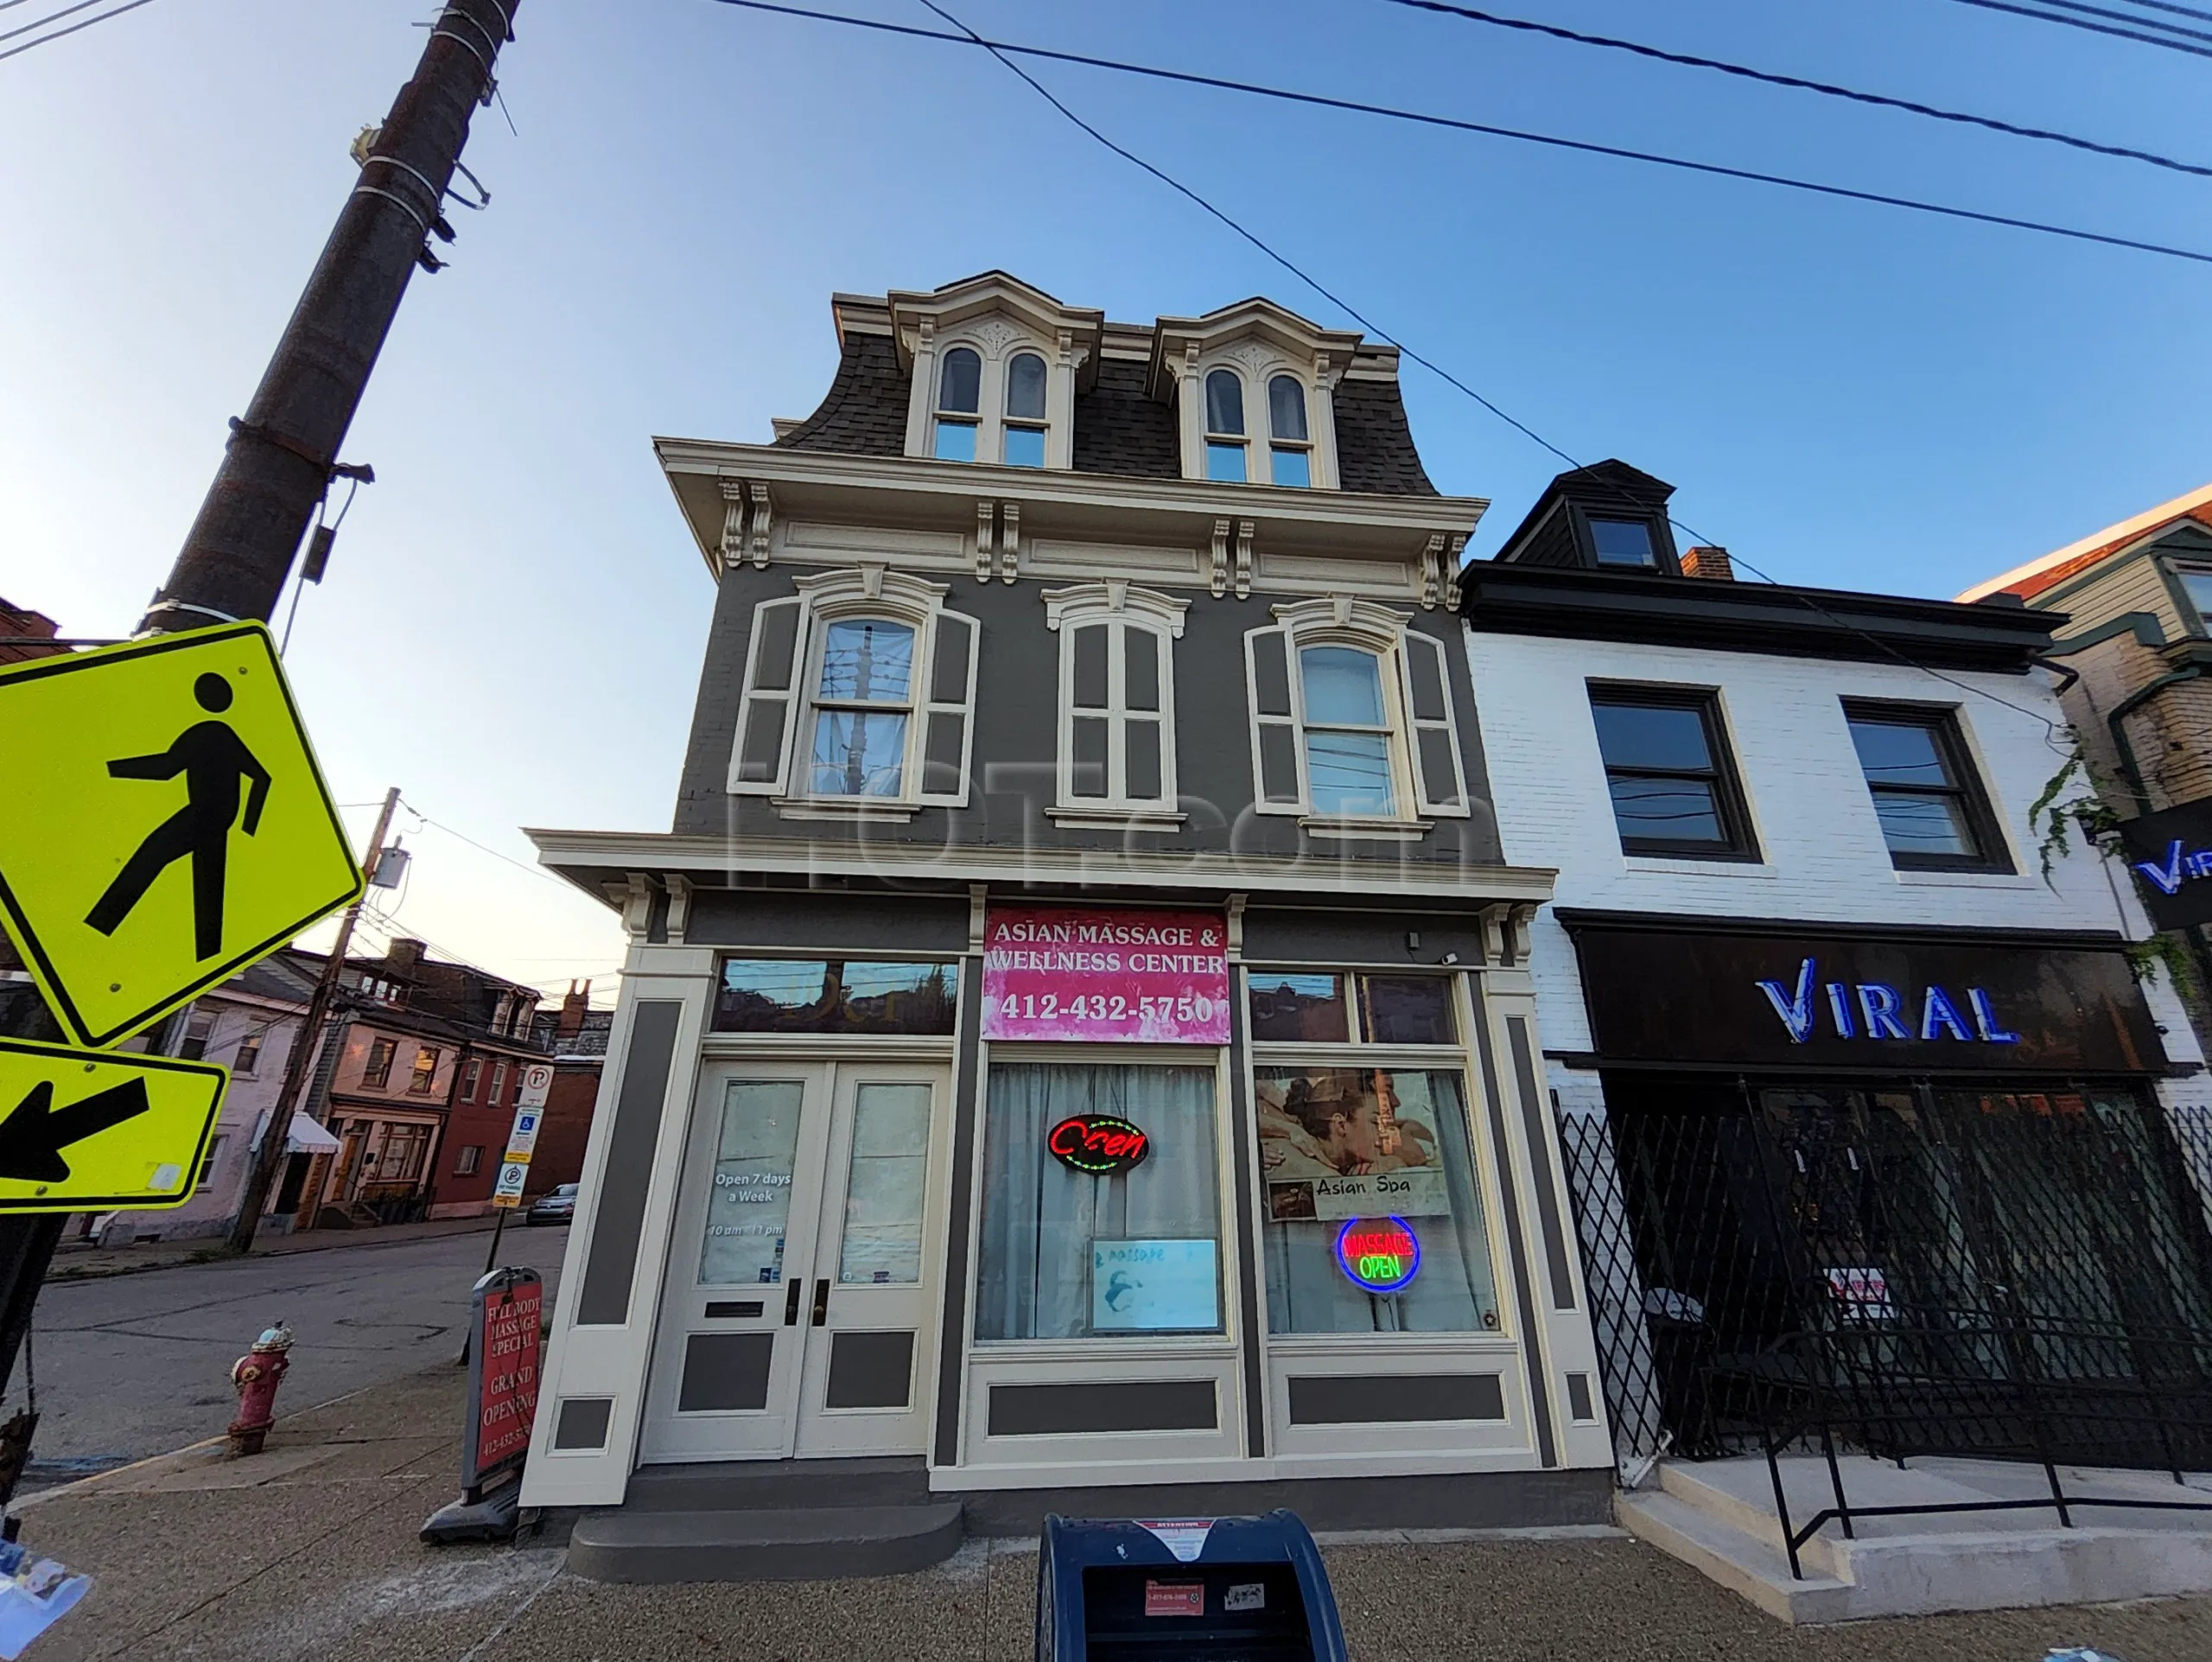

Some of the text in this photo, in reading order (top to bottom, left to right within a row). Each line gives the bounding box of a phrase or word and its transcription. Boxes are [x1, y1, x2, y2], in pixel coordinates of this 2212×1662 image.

[994, 922, 1220, 947] ASIAN MASSAGE &
[989, 950, 1225, 975] WELLNESS CENTER
[1000, 993, 1214, 1022] 412-432-5750
[1754, 957, 2021, 1045] VIRAL
[715, 1172, 791, 1188] Open 7 days
[1316, 1175, 1411, 1196] Asian Spa
[728, 1189, 773, 1202] a Week
[709, 1225, 723, 1236] 10
[724, 1226, 742, 1236] am
[764, 1226, 783, 1238] pm
[1343, 1232, 1414, 1258] MASSAGE
[1359, 1255, 1402, 1279] OPEN
[487, 1296, 542, 1323] FULL BODY
[490, 1314, 537, 1340] MASSAGE
[492, 1332, 534, 1358] SPECIAL
[490, 1366, 533, 1396] GRAND
[483, 1390, 536, 1427] OPENING
